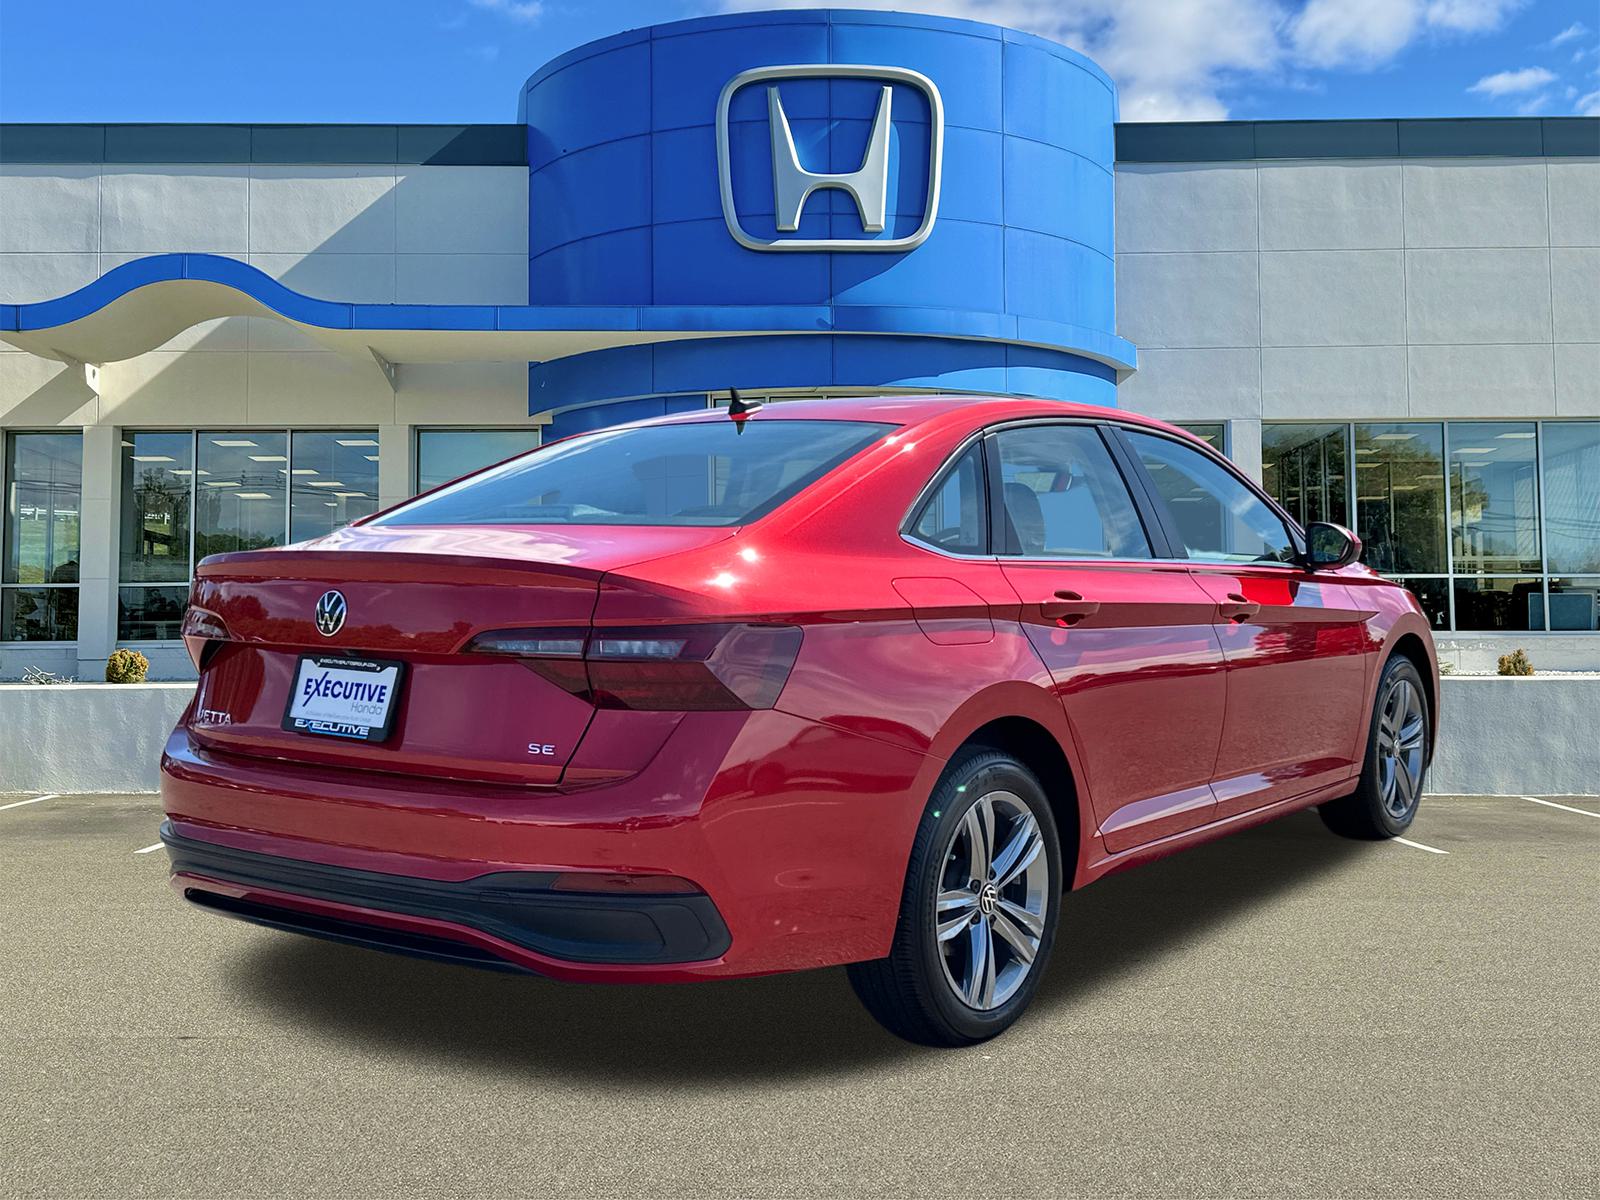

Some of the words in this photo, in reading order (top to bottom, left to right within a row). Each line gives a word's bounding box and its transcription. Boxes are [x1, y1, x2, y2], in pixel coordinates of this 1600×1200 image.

[302, 671, 387, 707] EXECUTIVE
[200, 709, 232, 725] JETTA
[351, 702, 383, 716] Honda
[294, 718, 370, 736] EXECUTIVE
[528, 743, 555, 755] SE
